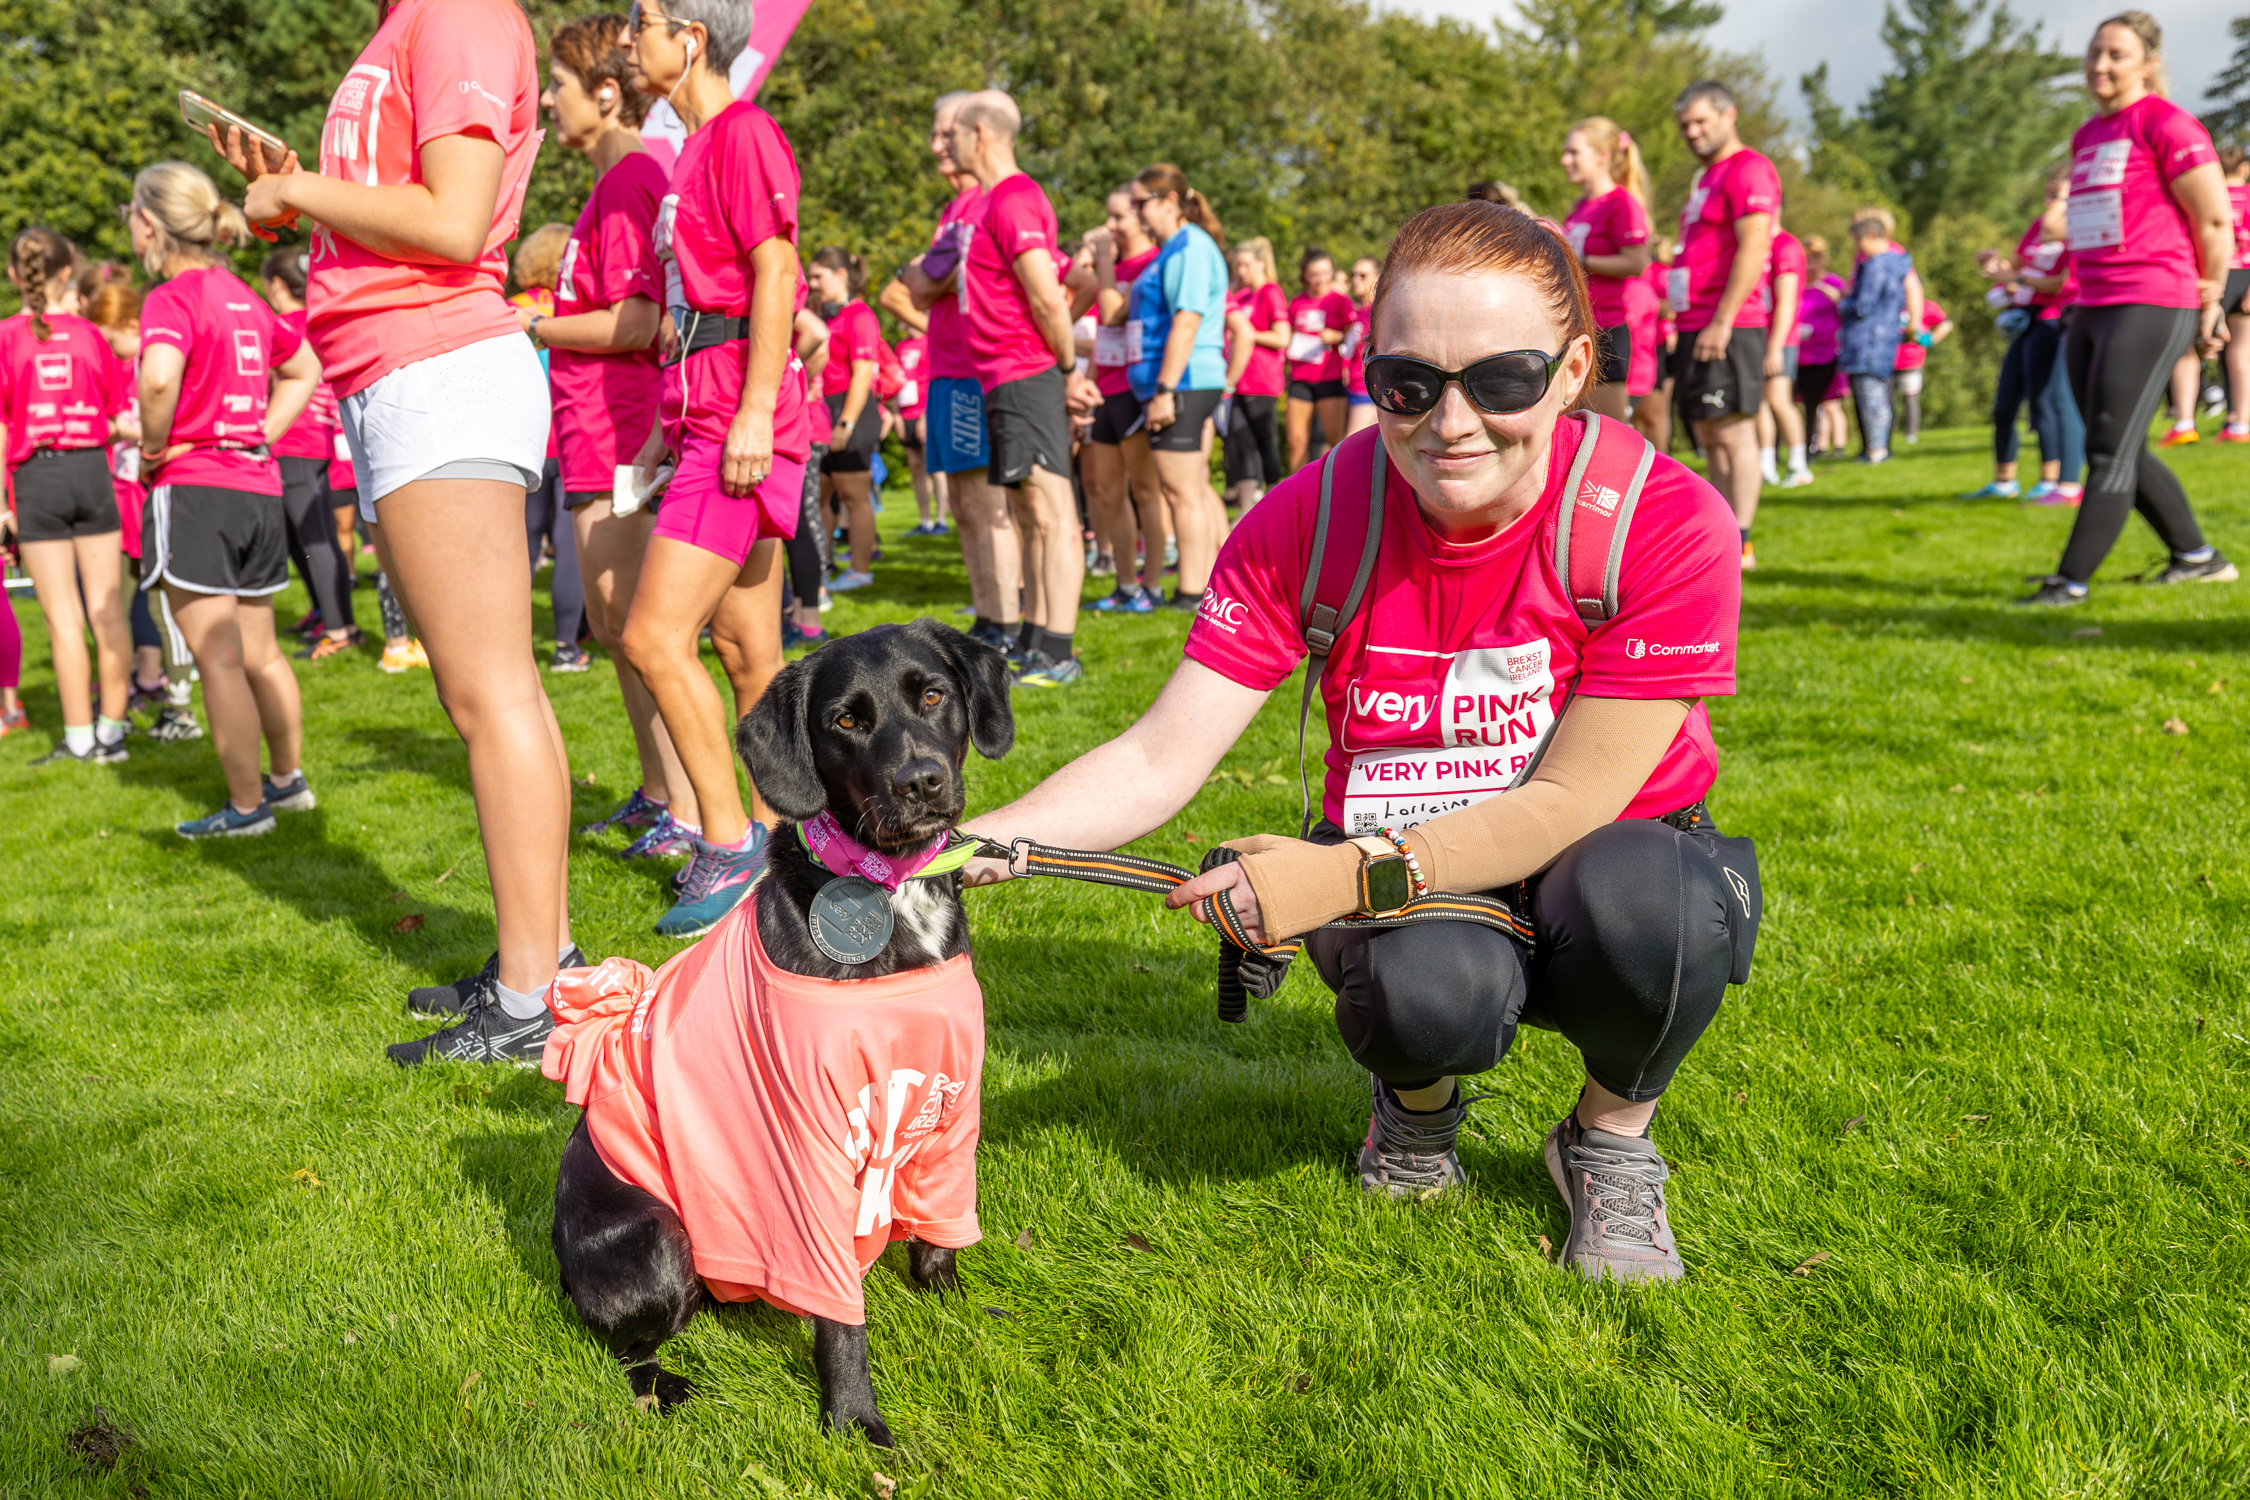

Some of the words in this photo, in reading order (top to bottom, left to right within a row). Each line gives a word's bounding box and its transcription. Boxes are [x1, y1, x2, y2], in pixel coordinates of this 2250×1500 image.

[951, 389, 981, 457] NIKE
[1200, 587, 1249, 625] PMC
[1649, 641, 1720, 656] Cornmarket
[1508, 660, 1543, 674] CANCER
[1510, 667, 1543, 681] IRELAND
[1354, 687, 1438, 732] very
[1453, 685, 1546, 724] PINK
[1454, 711, 1537, 747] RUN
[1364, 761, 1429, 782] VERY
[1435, 758, 1504, 780] PINK
[864, 856, 889, 879] CANCER
[868, 851, 893, 874] IRELAND
[829, 900, 853, 922] very
[846, 924, 866, 947] RUN
[854, 917, 875, 941] PINK
